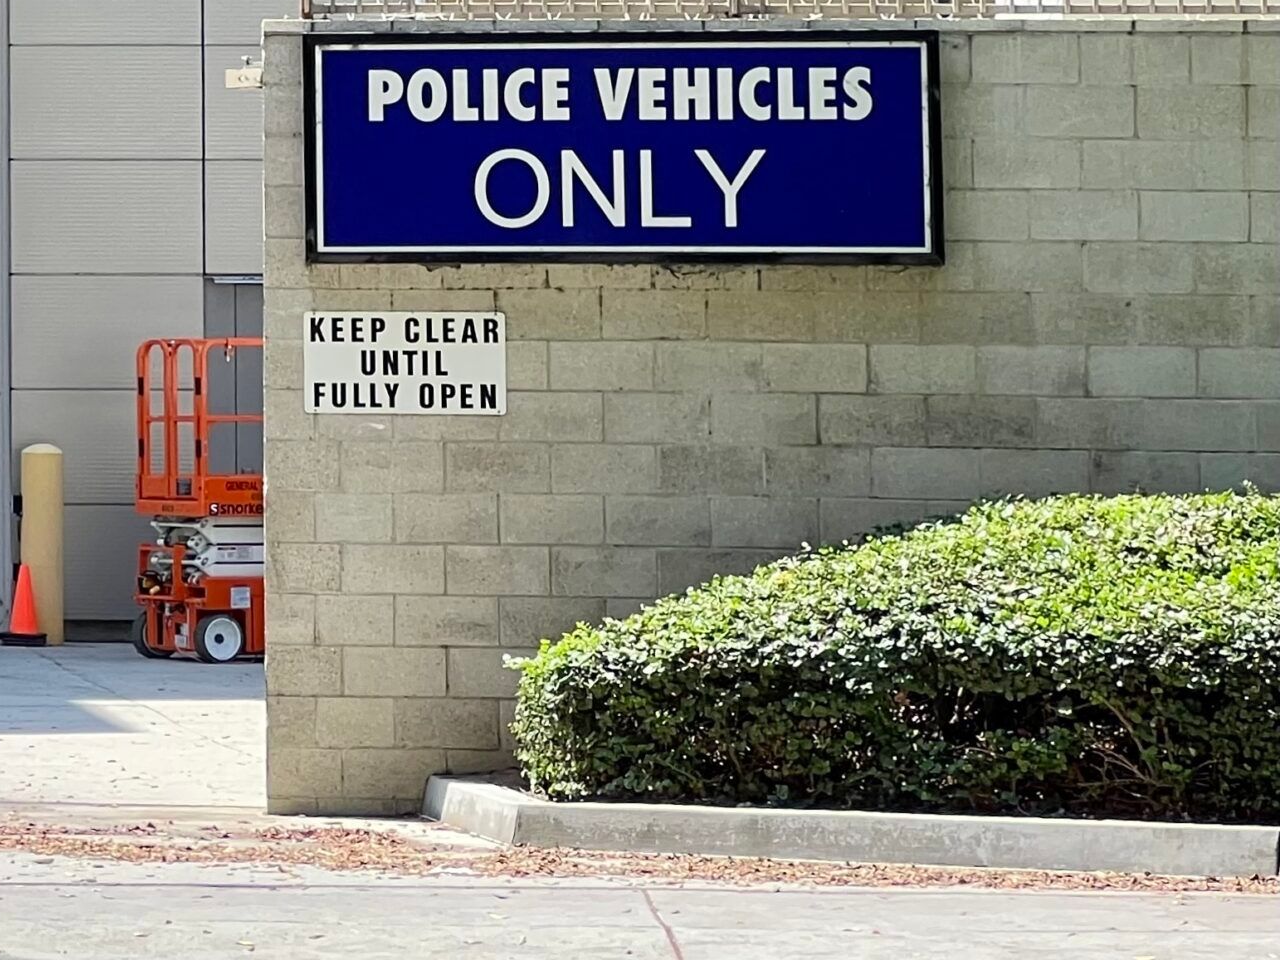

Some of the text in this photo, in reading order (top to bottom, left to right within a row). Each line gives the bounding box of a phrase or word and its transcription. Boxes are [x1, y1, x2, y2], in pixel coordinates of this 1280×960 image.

[368, 66, 873, 123] POLICE VEHICLES
[474, 148, 767, 229] ONLY
[310, 317, 499, 344] KEEP CLEAR
[360, 349, 449, 376] UNTIL
[313, 382, 498, 410] FULLY OPEN
[225, 480, 258, 491] GENERAL
